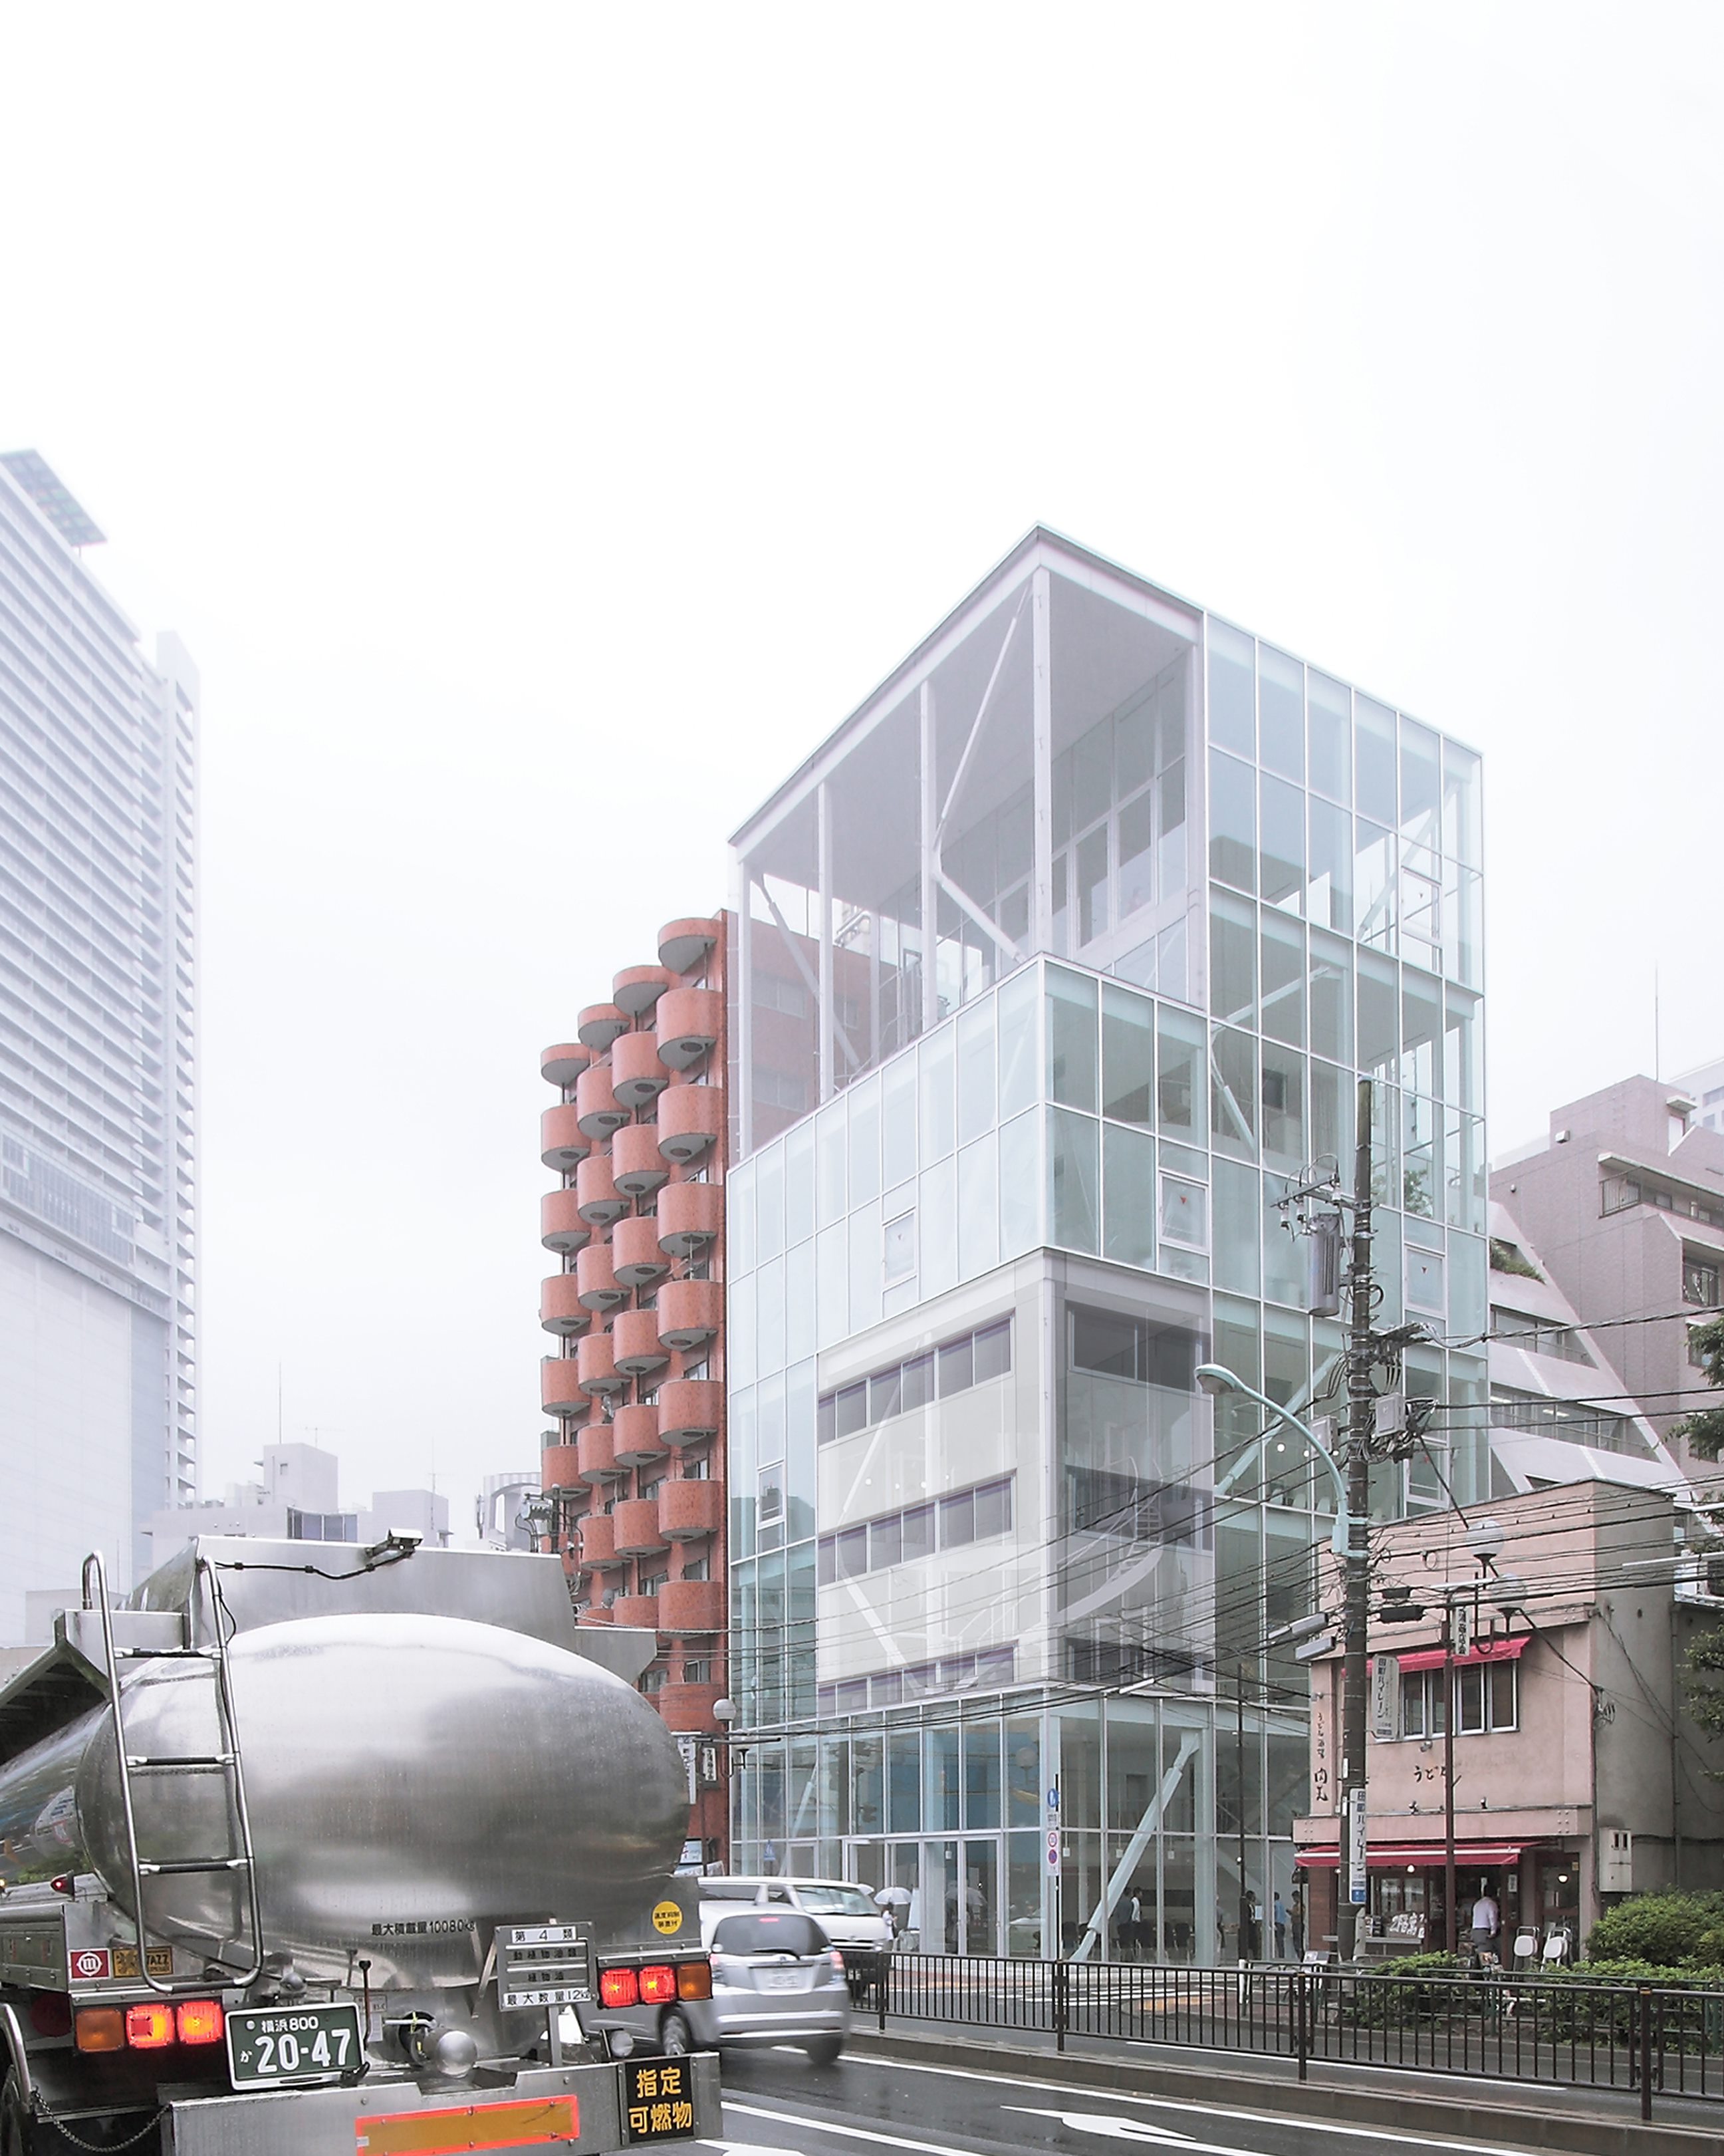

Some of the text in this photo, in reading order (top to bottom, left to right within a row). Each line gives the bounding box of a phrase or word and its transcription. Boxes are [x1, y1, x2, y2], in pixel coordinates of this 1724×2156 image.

[261, 2016, 319, 2033] 横浜800
[255, 2028, 351, 2074] 20-47
[636, 2066, 681, 2098] 指定
[628, 2101, 691, 2133] 可燃物
